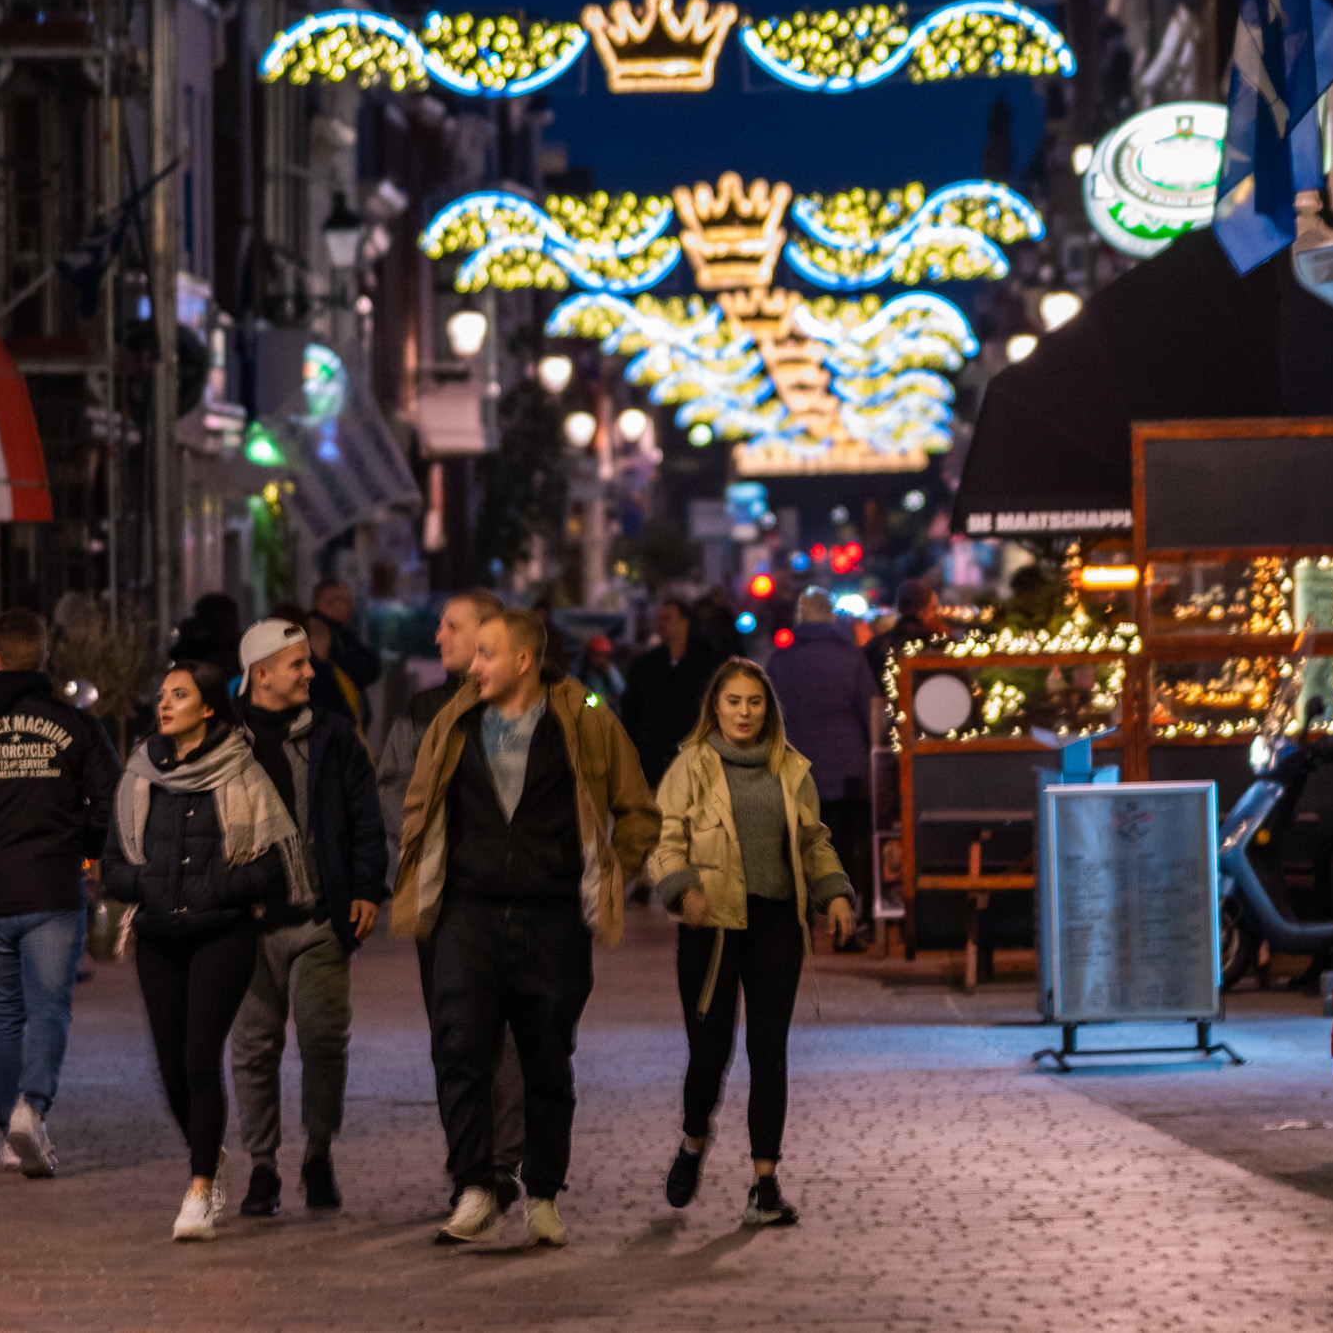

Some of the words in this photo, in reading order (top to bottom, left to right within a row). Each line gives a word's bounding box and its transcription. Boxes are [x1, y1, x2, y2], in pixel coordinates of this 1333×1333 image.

[967, 512, 992, 534] DE
[995, 509, 1134, 532] MAATSCHAPPI
[13, 713, 73, 752] MACHINA
[18, 757, 50, 769] SERVICE
